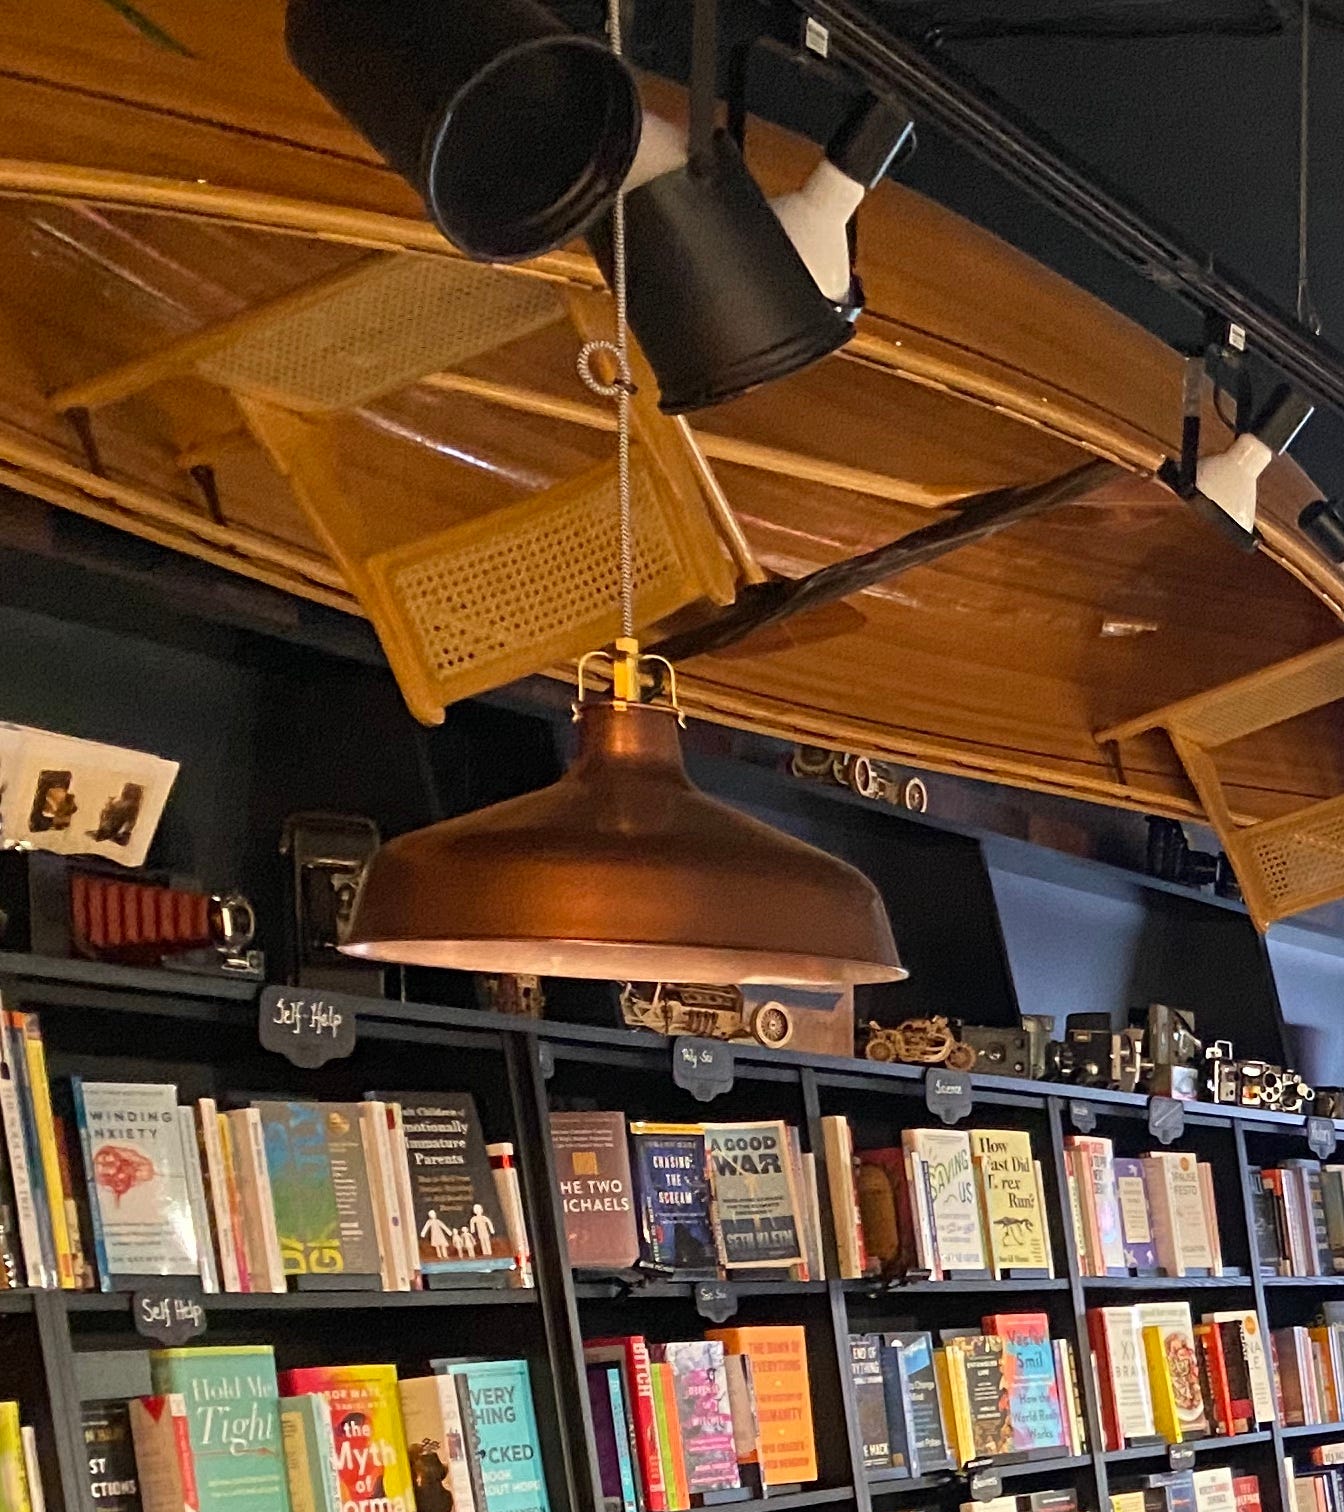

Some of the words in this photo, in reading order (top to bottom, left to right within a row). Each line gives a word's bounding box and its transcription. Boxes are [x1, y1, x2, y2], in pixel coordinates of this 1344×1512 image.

[90, 1110, 173, 1124] WINDING
[94, 1128, 158, 1140] NXIETY
[403, 1121, 468, 1136] motionally
[724, 1136, 777, 1151] GOOD
[979, 1137, 1007, 1153] How
[415, 1153, 464, 1166] Parents
[653, 1155, 692, 1169] CHASING
[714, 1153, 782, 1176] WAR
[1012, 1157, 1031, 1173] Did
[560, 1181, 582, 1196] HE
[588, 1179, 623, 1194] TWO
[666, 1174, 681, 1187] THE
[1001, 1178, 1021, 1190] rex
[659, 1192, 692, 1205] SCREAM
[959, 1182, 973, 1204] US
[563, 1197, 630, 1213] ICHAELS
[142, 1299, 170, 1327] Self
[174, 1298, 203, 1327] Help
[1016, 1351, 1043, 1369] Smil
[633, 1342, 650, 1397] BITCH
[192, 1376, 241, 1402] Hold
[247, 1375, 274, 1398] Me
[470, 1386, 516, 1407] VERY
[475, 1406, 517, 1426] HING
[197, 1402, 274, 1457] Tight
[343, 1421, 370, 1439] the
[333, 1440, 397, 1476] Myth
[477, 1444, 534, 1464] CKED
[88, 1458, 106, 1475] ST
[91, 1478, 136, 1499] CTIONS
[355, 1477, 374, 1493] of
[485, 1483, 509, 1496] OUT
